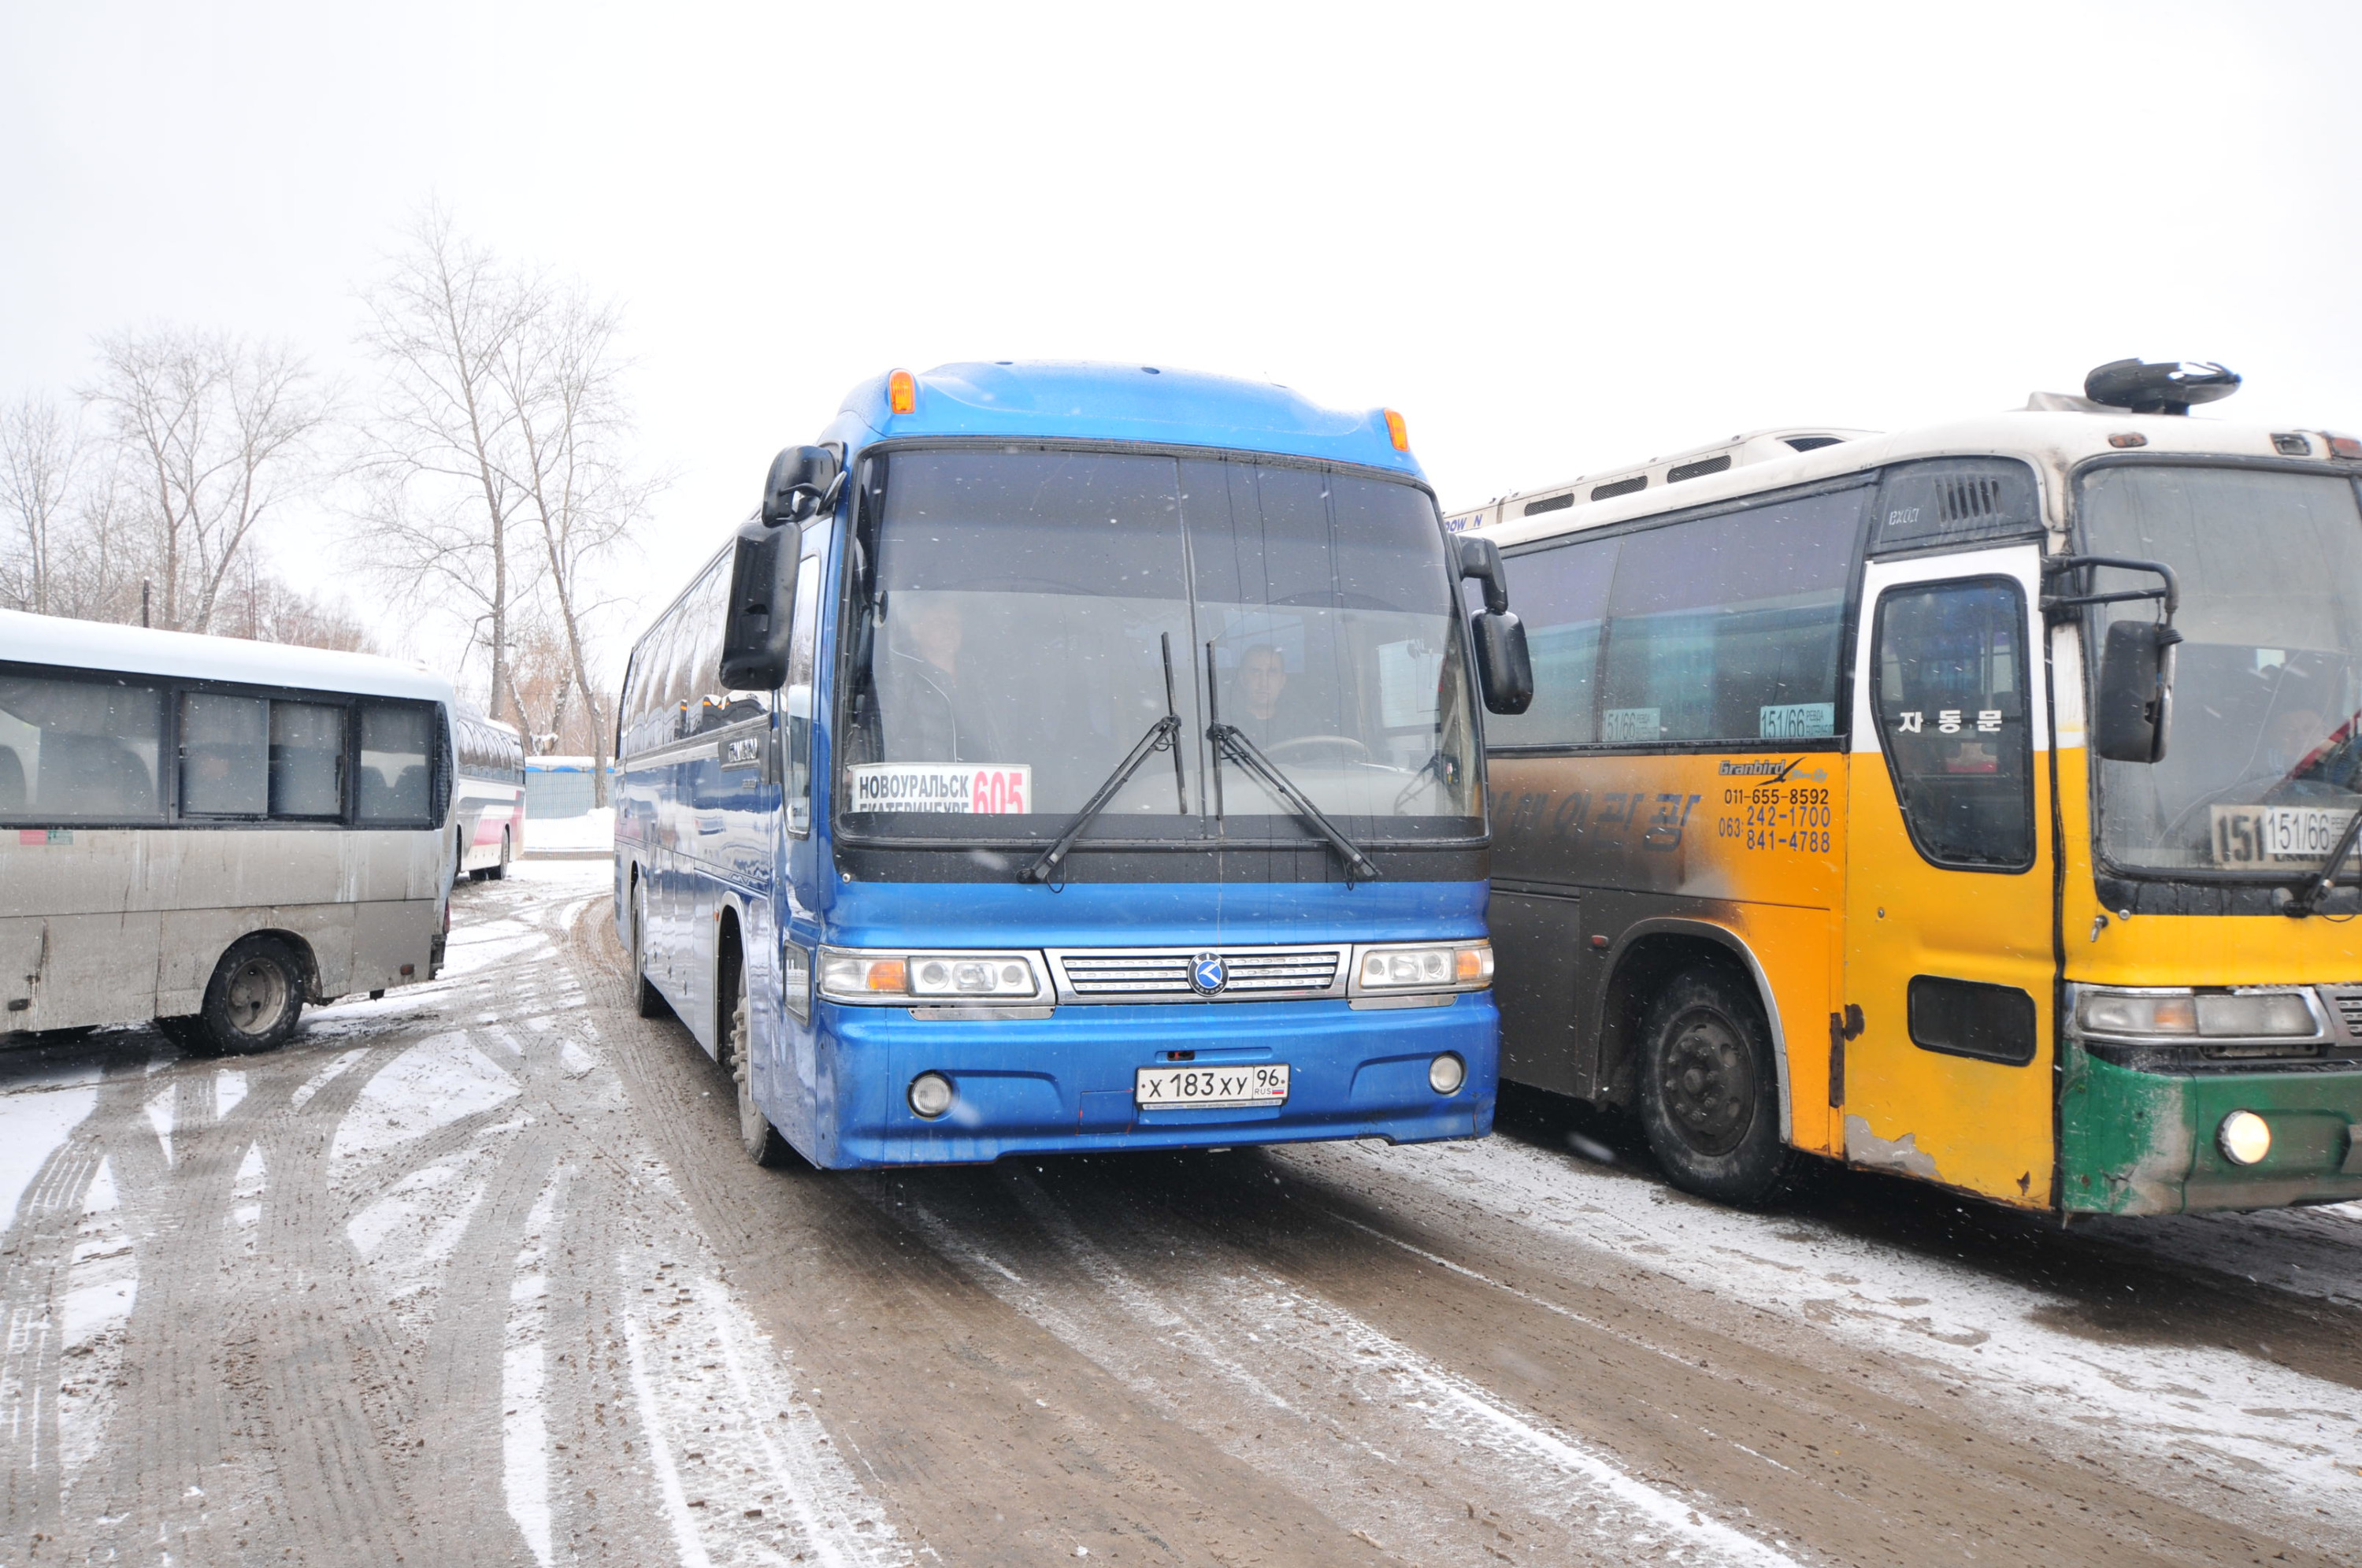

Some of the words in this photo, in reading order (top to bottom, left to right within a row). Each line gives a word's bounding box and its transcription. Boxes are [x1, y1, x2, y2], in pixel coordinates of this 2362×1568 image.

[1762, 709, 1804, 738] 151/66
[1719, 759, 1785, 775] Granbird
[859, 775, 969, 799] НОВОУРАЛЬСК
[973, 771, 1023, 814] 605
[1725, 788, 1829, 805] 011-655-8592
[1747, 806, 1831, 827] 242-1700
[1747, 829, 1830, 853] 841-4788
[2219, 814, 2265, 862] 151
[2268, 813, 2329, 850] 151/66
[1256, 1069, 1279, 1088] 96
